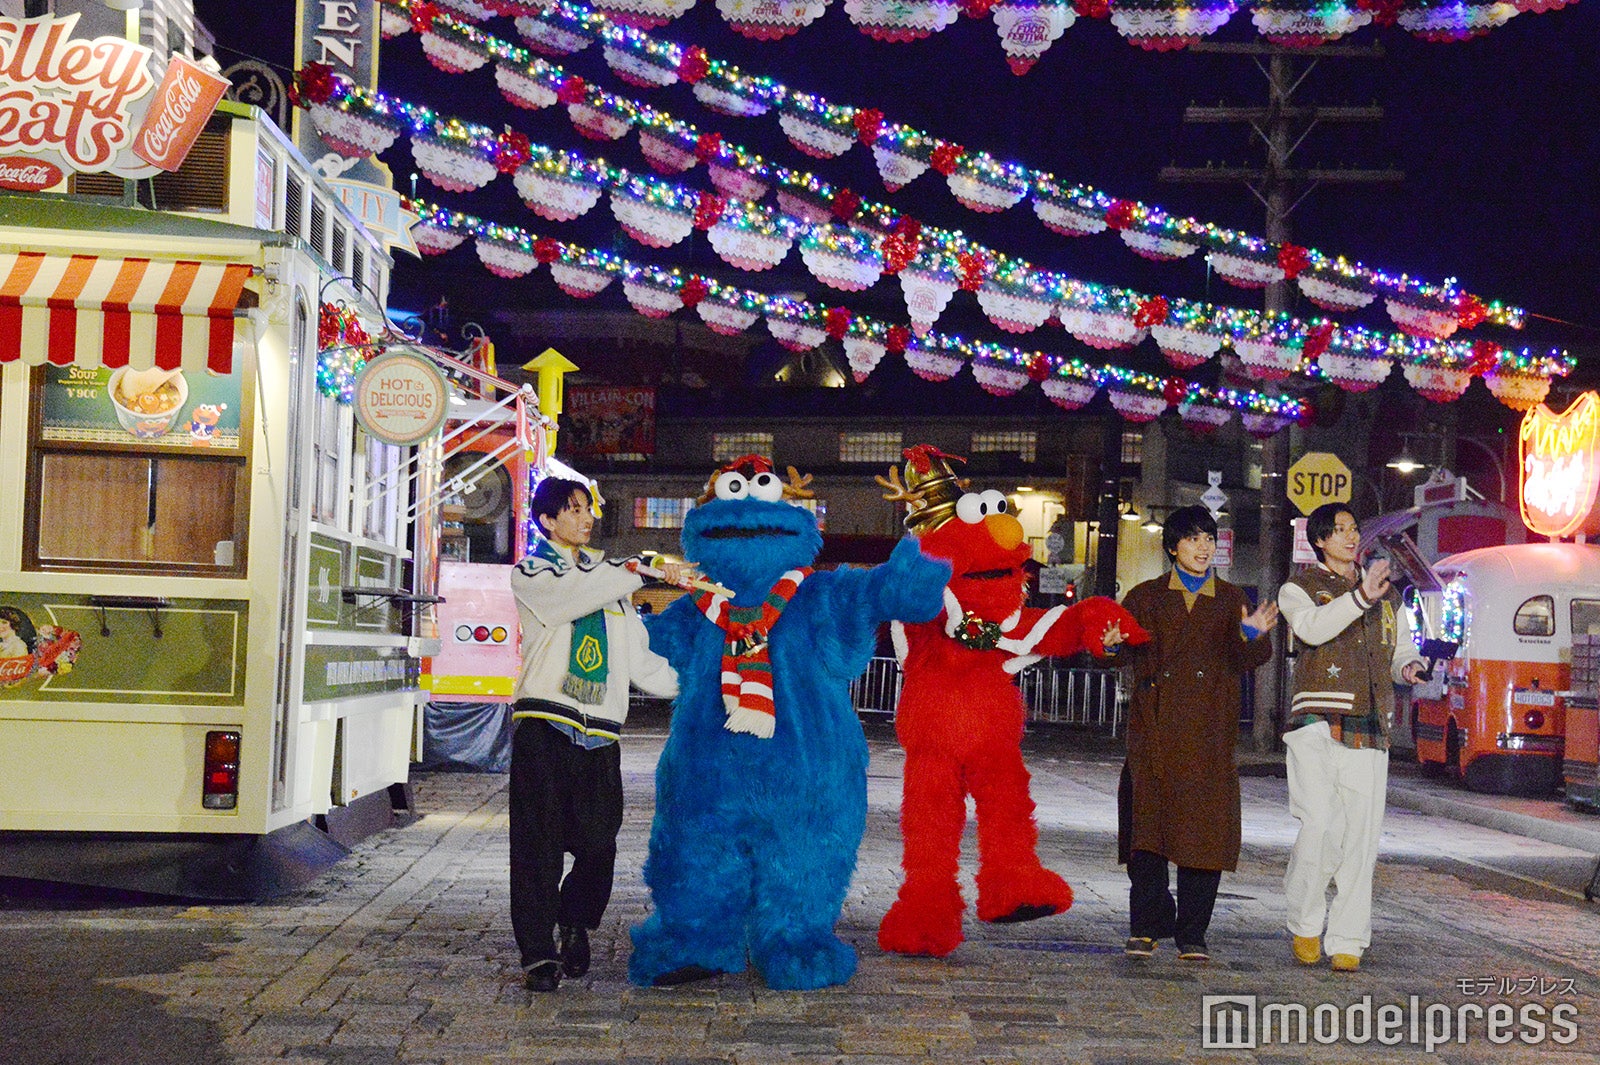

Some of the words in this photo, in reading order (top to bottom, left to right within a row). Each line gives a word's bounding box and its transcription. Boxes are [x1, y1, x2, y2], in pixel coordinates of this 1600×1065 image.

[1007, 32, 1048, 42] FESTIVAL
[0, 22, 148, 121] lley
[331, 187, 390, 226] ETY
[380, 378, 413, 391] HOT
[370, 391, 433, 409] DELICIOUS
[1293, 471, 1348, 497] STOP
